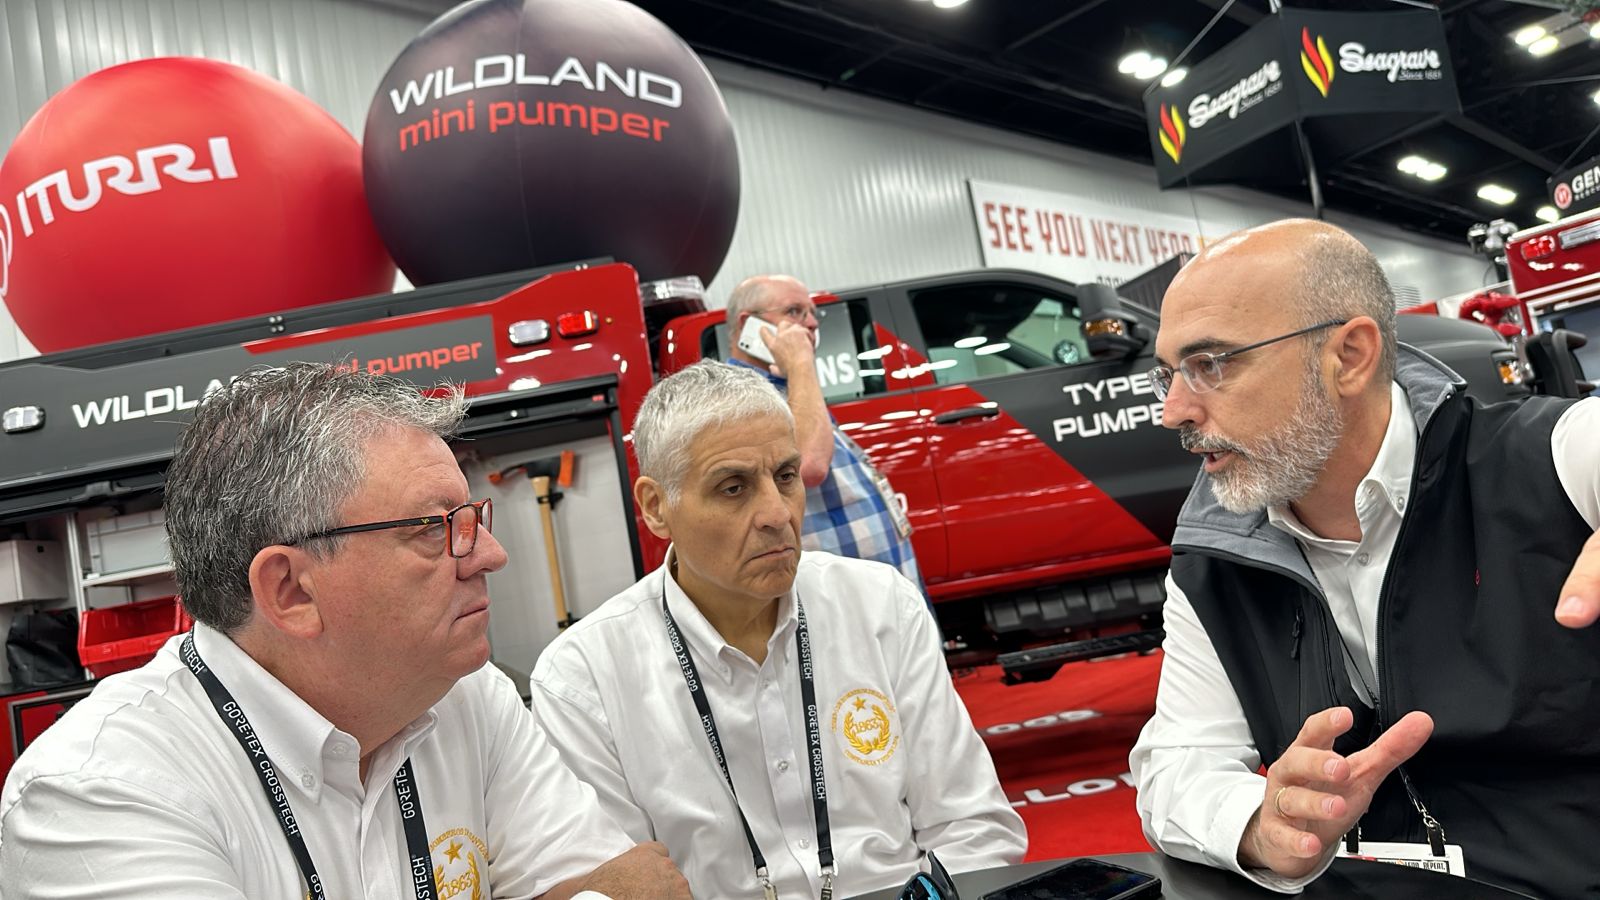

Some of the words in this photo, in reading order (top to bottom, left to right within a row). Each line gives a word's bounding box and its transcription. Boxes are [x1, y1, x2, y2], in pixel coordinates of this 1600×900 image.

[390, 53, 682, 115] WILDLAND
[1339, 42, 1440, 82] Seagrave
[1188, 60, 1282, 128] Seagrave
[400, 99, 475, 151] mini
[488, 101, 669, 142] pumper
[16, 136, 238, 237] ITURRI
[983, 202, 1033, 252] SEE
[1035, 208, 1087, 258] YOU
[1090, 218, 1144, 266] NEXT
[1062, 373, 1153, 405] TYPE
[800, 631, 812, 680] CROSSTECH
[223, 701, 265, 757] GORE-TEX
[259, 760, 299, 836] CROSSTECH
[395, 766, 416, 819] GORE-TE
[813, 747, 826, 800] CROSSTECH
[412, 856, 431, 900] STECH
[443, 870, 473, 899] 1863
